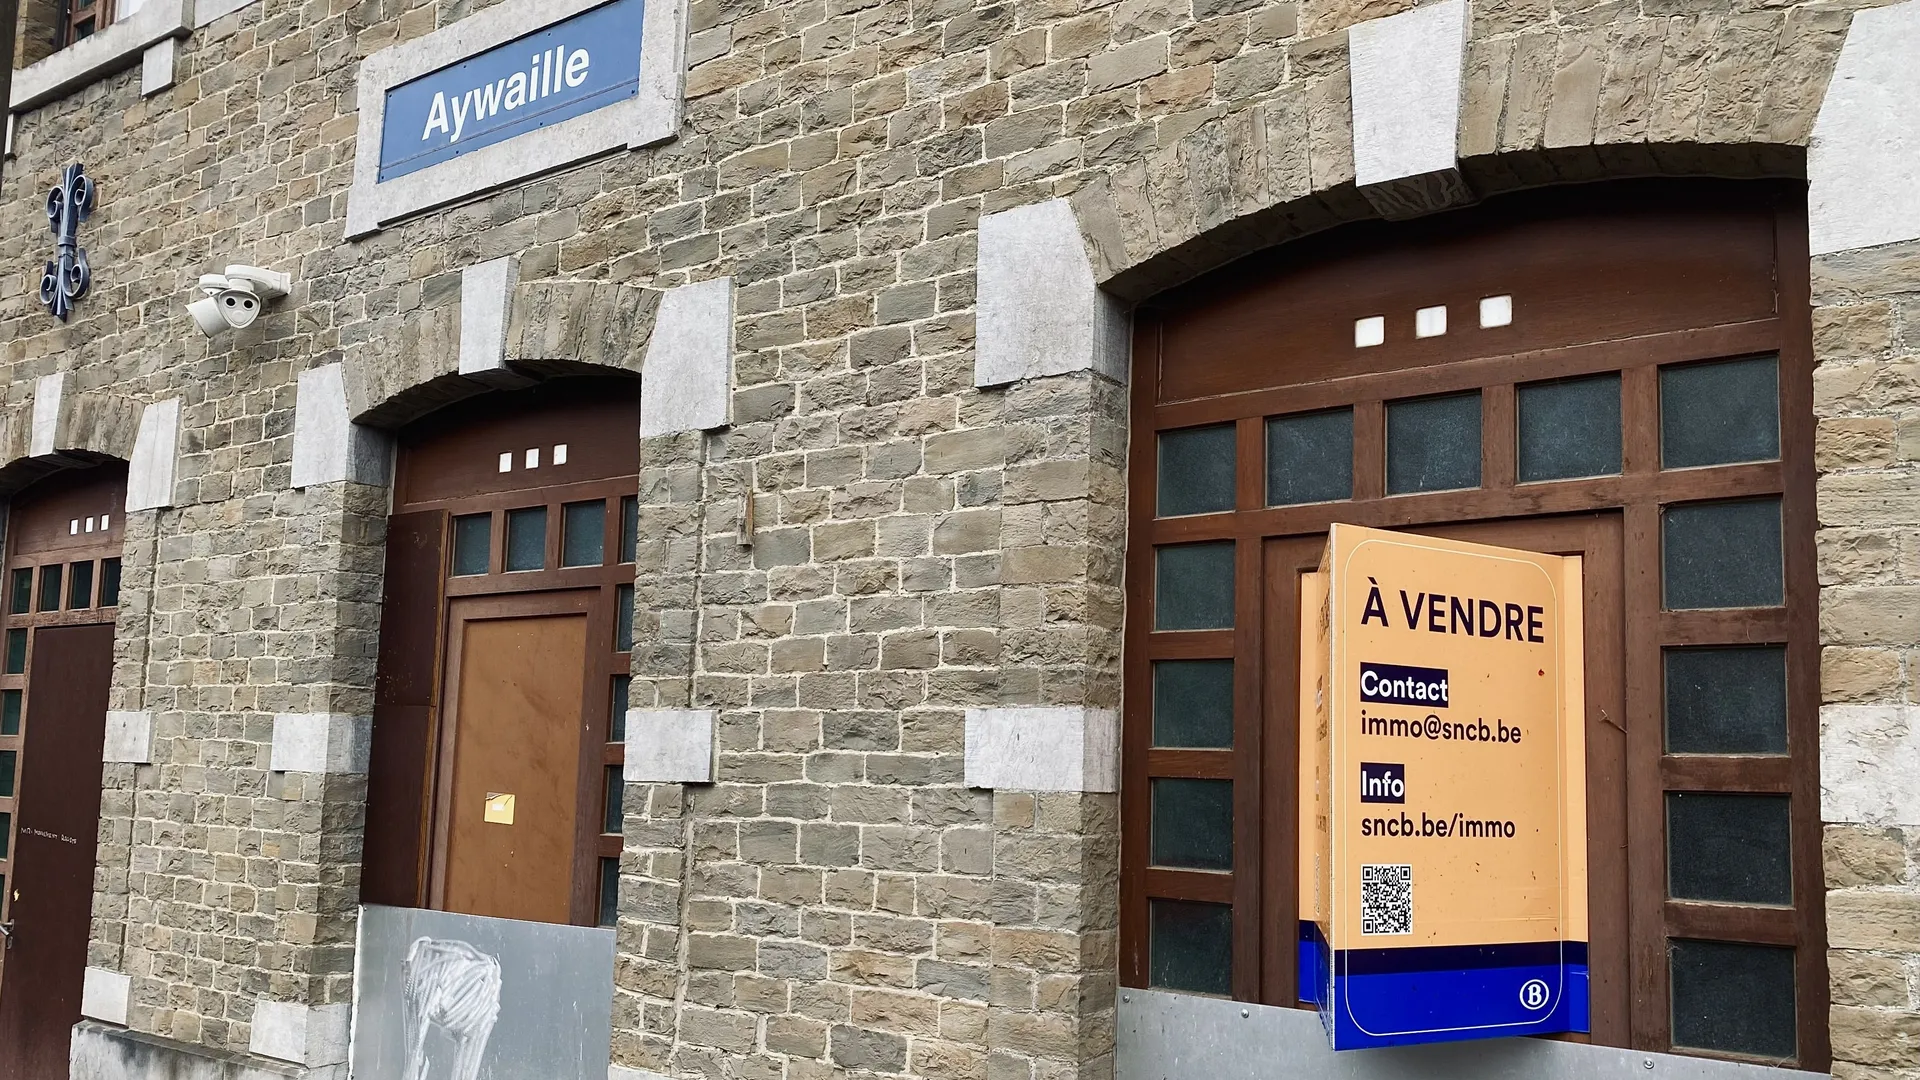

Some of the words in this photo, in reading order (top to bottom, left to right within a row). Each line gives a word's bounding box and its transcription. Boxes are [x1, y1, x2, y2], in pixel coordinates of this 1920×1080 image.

[421, 44, 590, 143] Aywaille
[1361, 576, 1389, 628] À
[1399, 589, 1545, 644] VENDRE
[1361, 670, 1448, 702] Contact
[1361, 709, 1522, 744] immo@sncb.be
[1361, 770, 1405, 798] Info
[1361, 812, 1516, 838] sncb.be/immo
